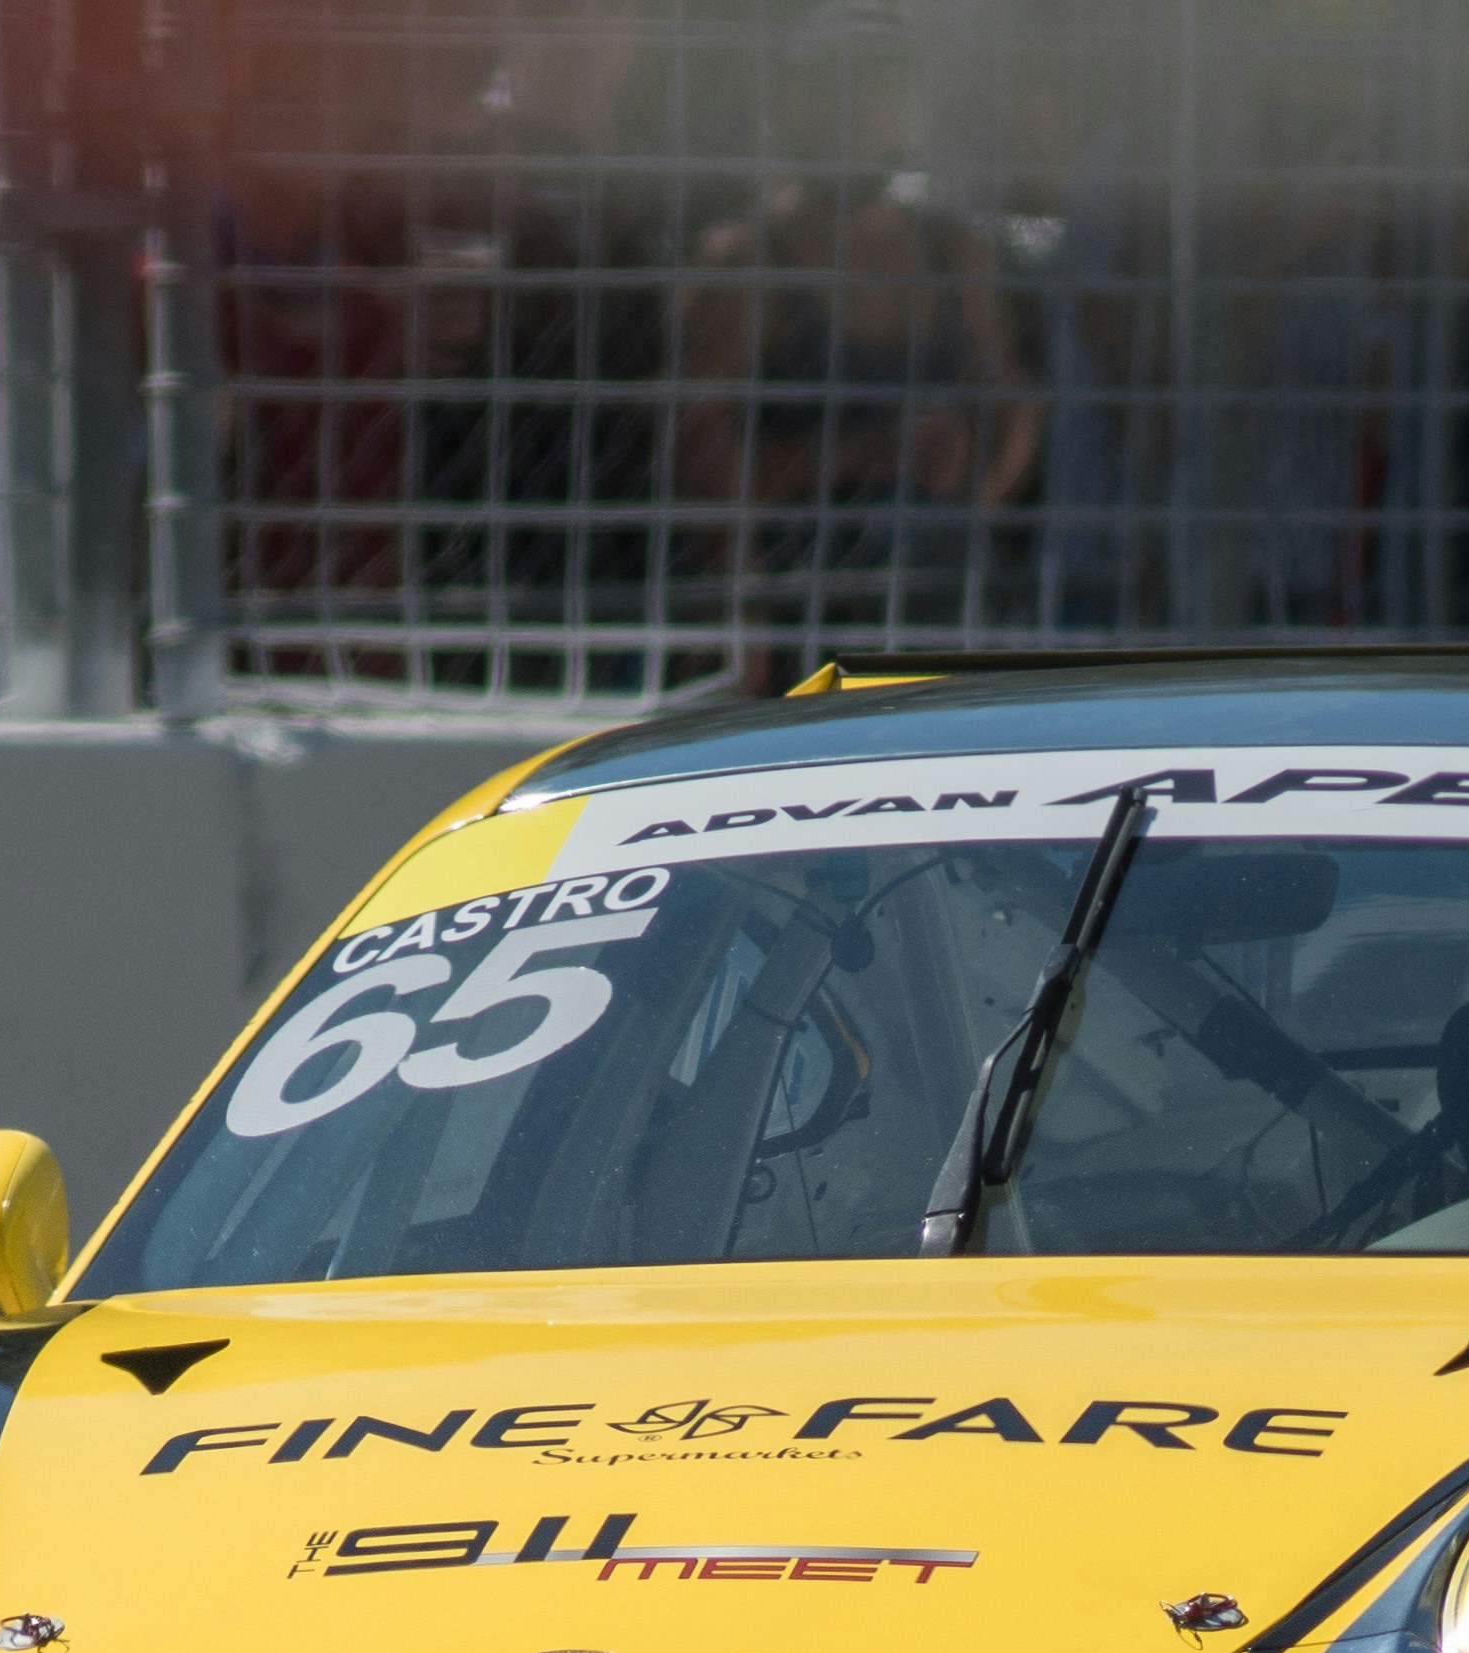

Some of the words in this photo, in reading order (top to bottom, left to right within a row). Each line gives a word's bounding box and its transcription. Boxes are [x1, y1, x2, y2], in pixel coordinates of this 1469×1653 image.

[617, 789, 1019, 846] ADVAN
[332, 867, 671, 975] CASTRO
[225, 906, 659, 1138] 65
[138, 1402, 598, 1476] FINE
[792, 1396, 1351, 1458] FARE
[531, 1447, 863, 1466] Supermarkets
[286, 1530, 339, 1579] THE
[323, 1512, 638, 1577] 911
[596, 1556, 978, 1584] MEET
